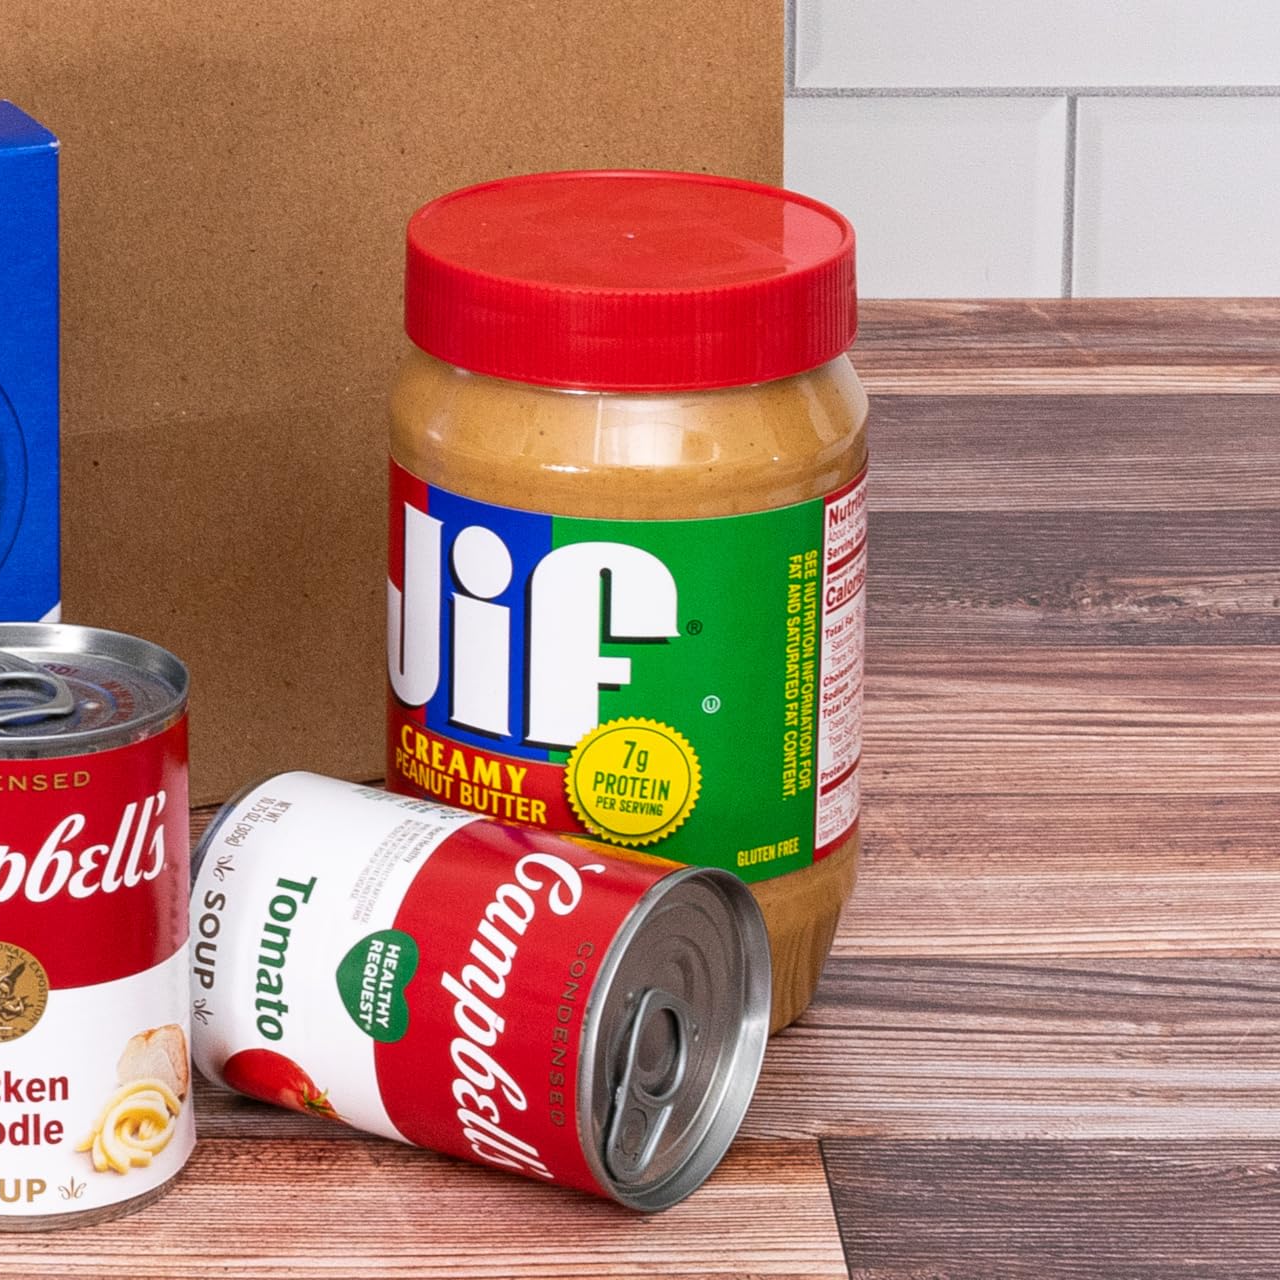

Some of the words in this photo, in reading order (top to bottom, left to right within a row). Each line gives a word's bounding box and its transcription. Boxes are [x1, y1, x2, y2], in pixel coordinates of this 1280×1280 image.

[787, 583, 801, 614] AND
[788, 554, 803, 580] FAT
[804, 549, 818, 579] SEE
[802, 581, 817, 658] NUTRITION
[785, 616, 801, 700] SATURATED
[785, 701, 799, 727] FAT
[799, 659, 815, 758] INFORMATION
[395, 749, 455, 799] PEANUT
[459, 782, 548, 825] BUTTER
[400, 725, 528, 795] CREAMY
[593, 771, 670, 801] PROTEIN
[623, 739, 649, 773] 7g
[782, 730, 798, 801] CONTENT.
[798, 759, 812, 791] FOR
[595, 795, 617, 813] PER
[618, 798, 664, 817] SERVING
[737, 842, 770, 867] GLUTEN
[771, 837, 800, 861] FREE
[194, 889, 227, 990] SOUP
[255, 876, 318, 1041] Tomato
[359, 939, 385, 1025] REQUEST
[374, 943, 402, 1029] HEALTHY
[440, 852, 606, 1179] Campbell's
[548, 940, 595, 1127] CONDENSED
